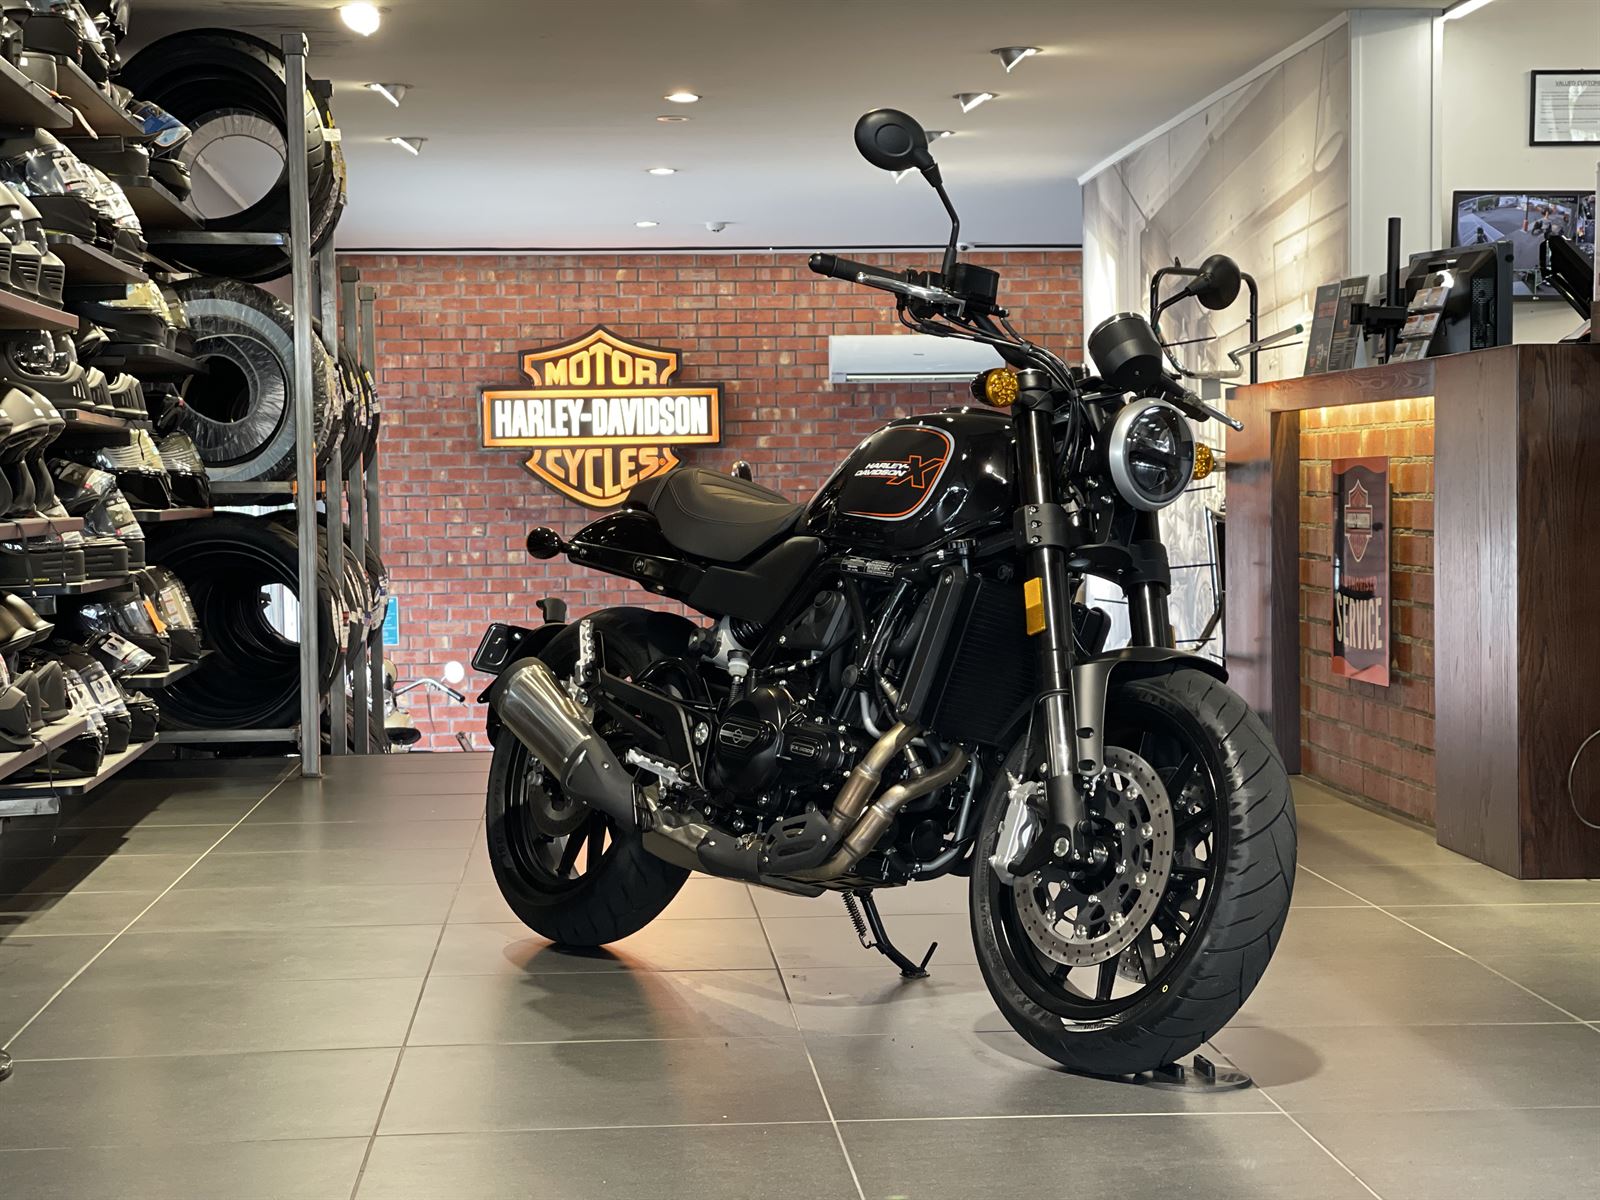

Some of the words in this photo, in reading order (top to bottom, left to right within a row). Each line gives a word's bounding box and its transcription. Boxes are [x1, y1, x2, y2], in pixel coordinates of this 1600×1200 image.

[544, 341, 658, 386] MOTOR
[494, 396, 708, 438] HARLEY-DAVIDSON
[545, 447, 660, 498] CYCLES
[854, 469, 908, 477] DAVIDSON
[1336, 591, 1382, 650] SERVICE
